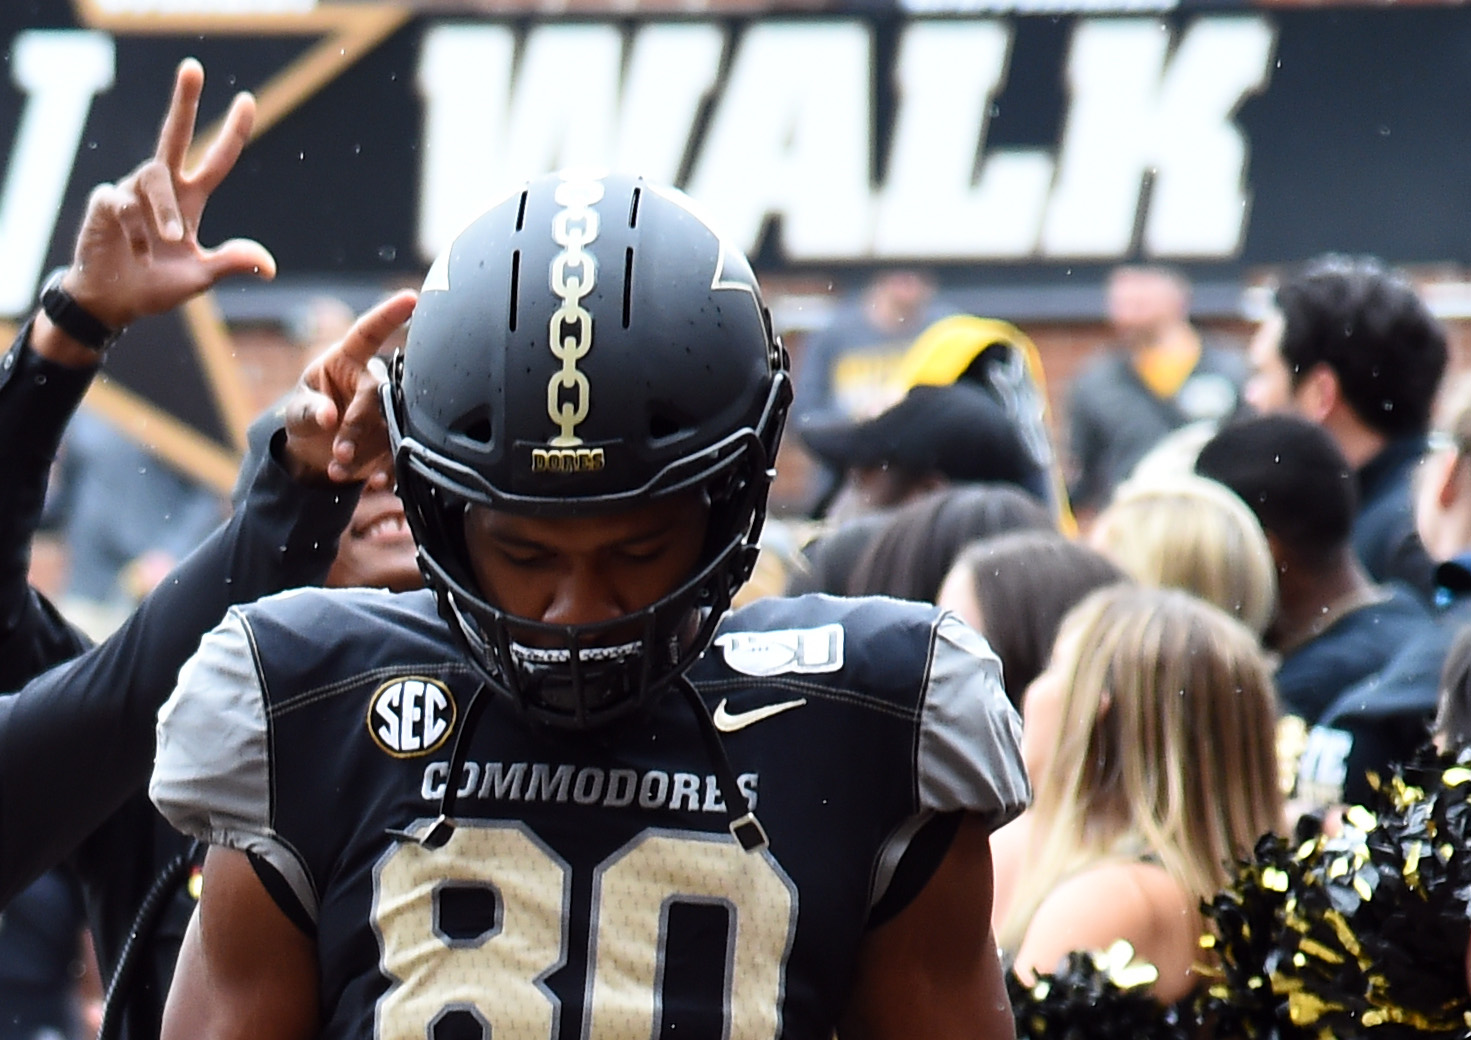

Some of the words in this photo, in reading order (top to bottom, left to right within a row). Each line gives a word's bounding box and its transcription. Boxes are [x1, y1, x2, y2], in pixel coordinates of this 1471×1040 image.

[415, 18, 1278, 262] WALK
[531, 448, 605, 472] DORES
[375, 679, 449, 751] SEC
